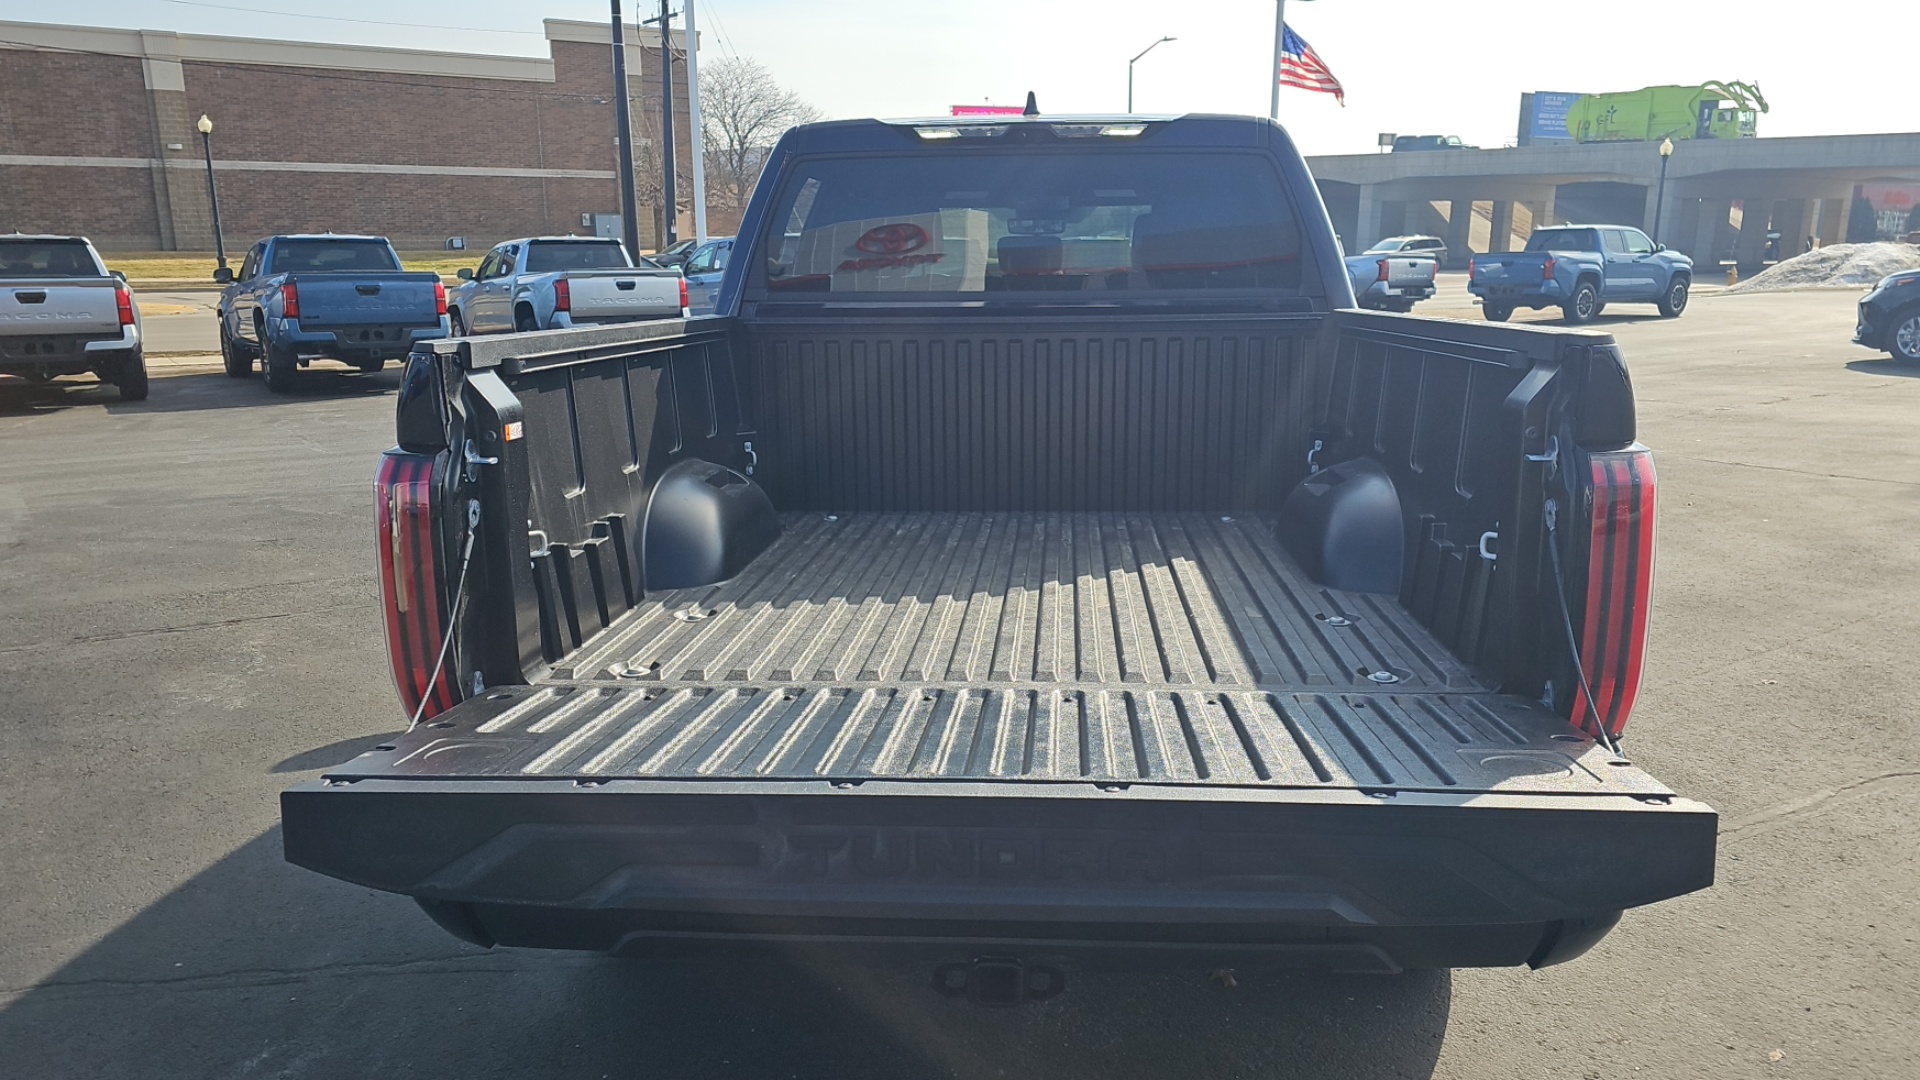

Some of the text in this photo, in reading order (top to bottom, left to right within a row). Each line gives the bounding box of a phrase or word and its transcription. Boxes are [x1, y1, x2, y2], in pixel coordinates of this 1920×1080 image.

[588, 296, 665, 305] TACOMA
[0, 311, 93, 320] ACOMA
[788, 834, 1167, 882] TUNDRA
